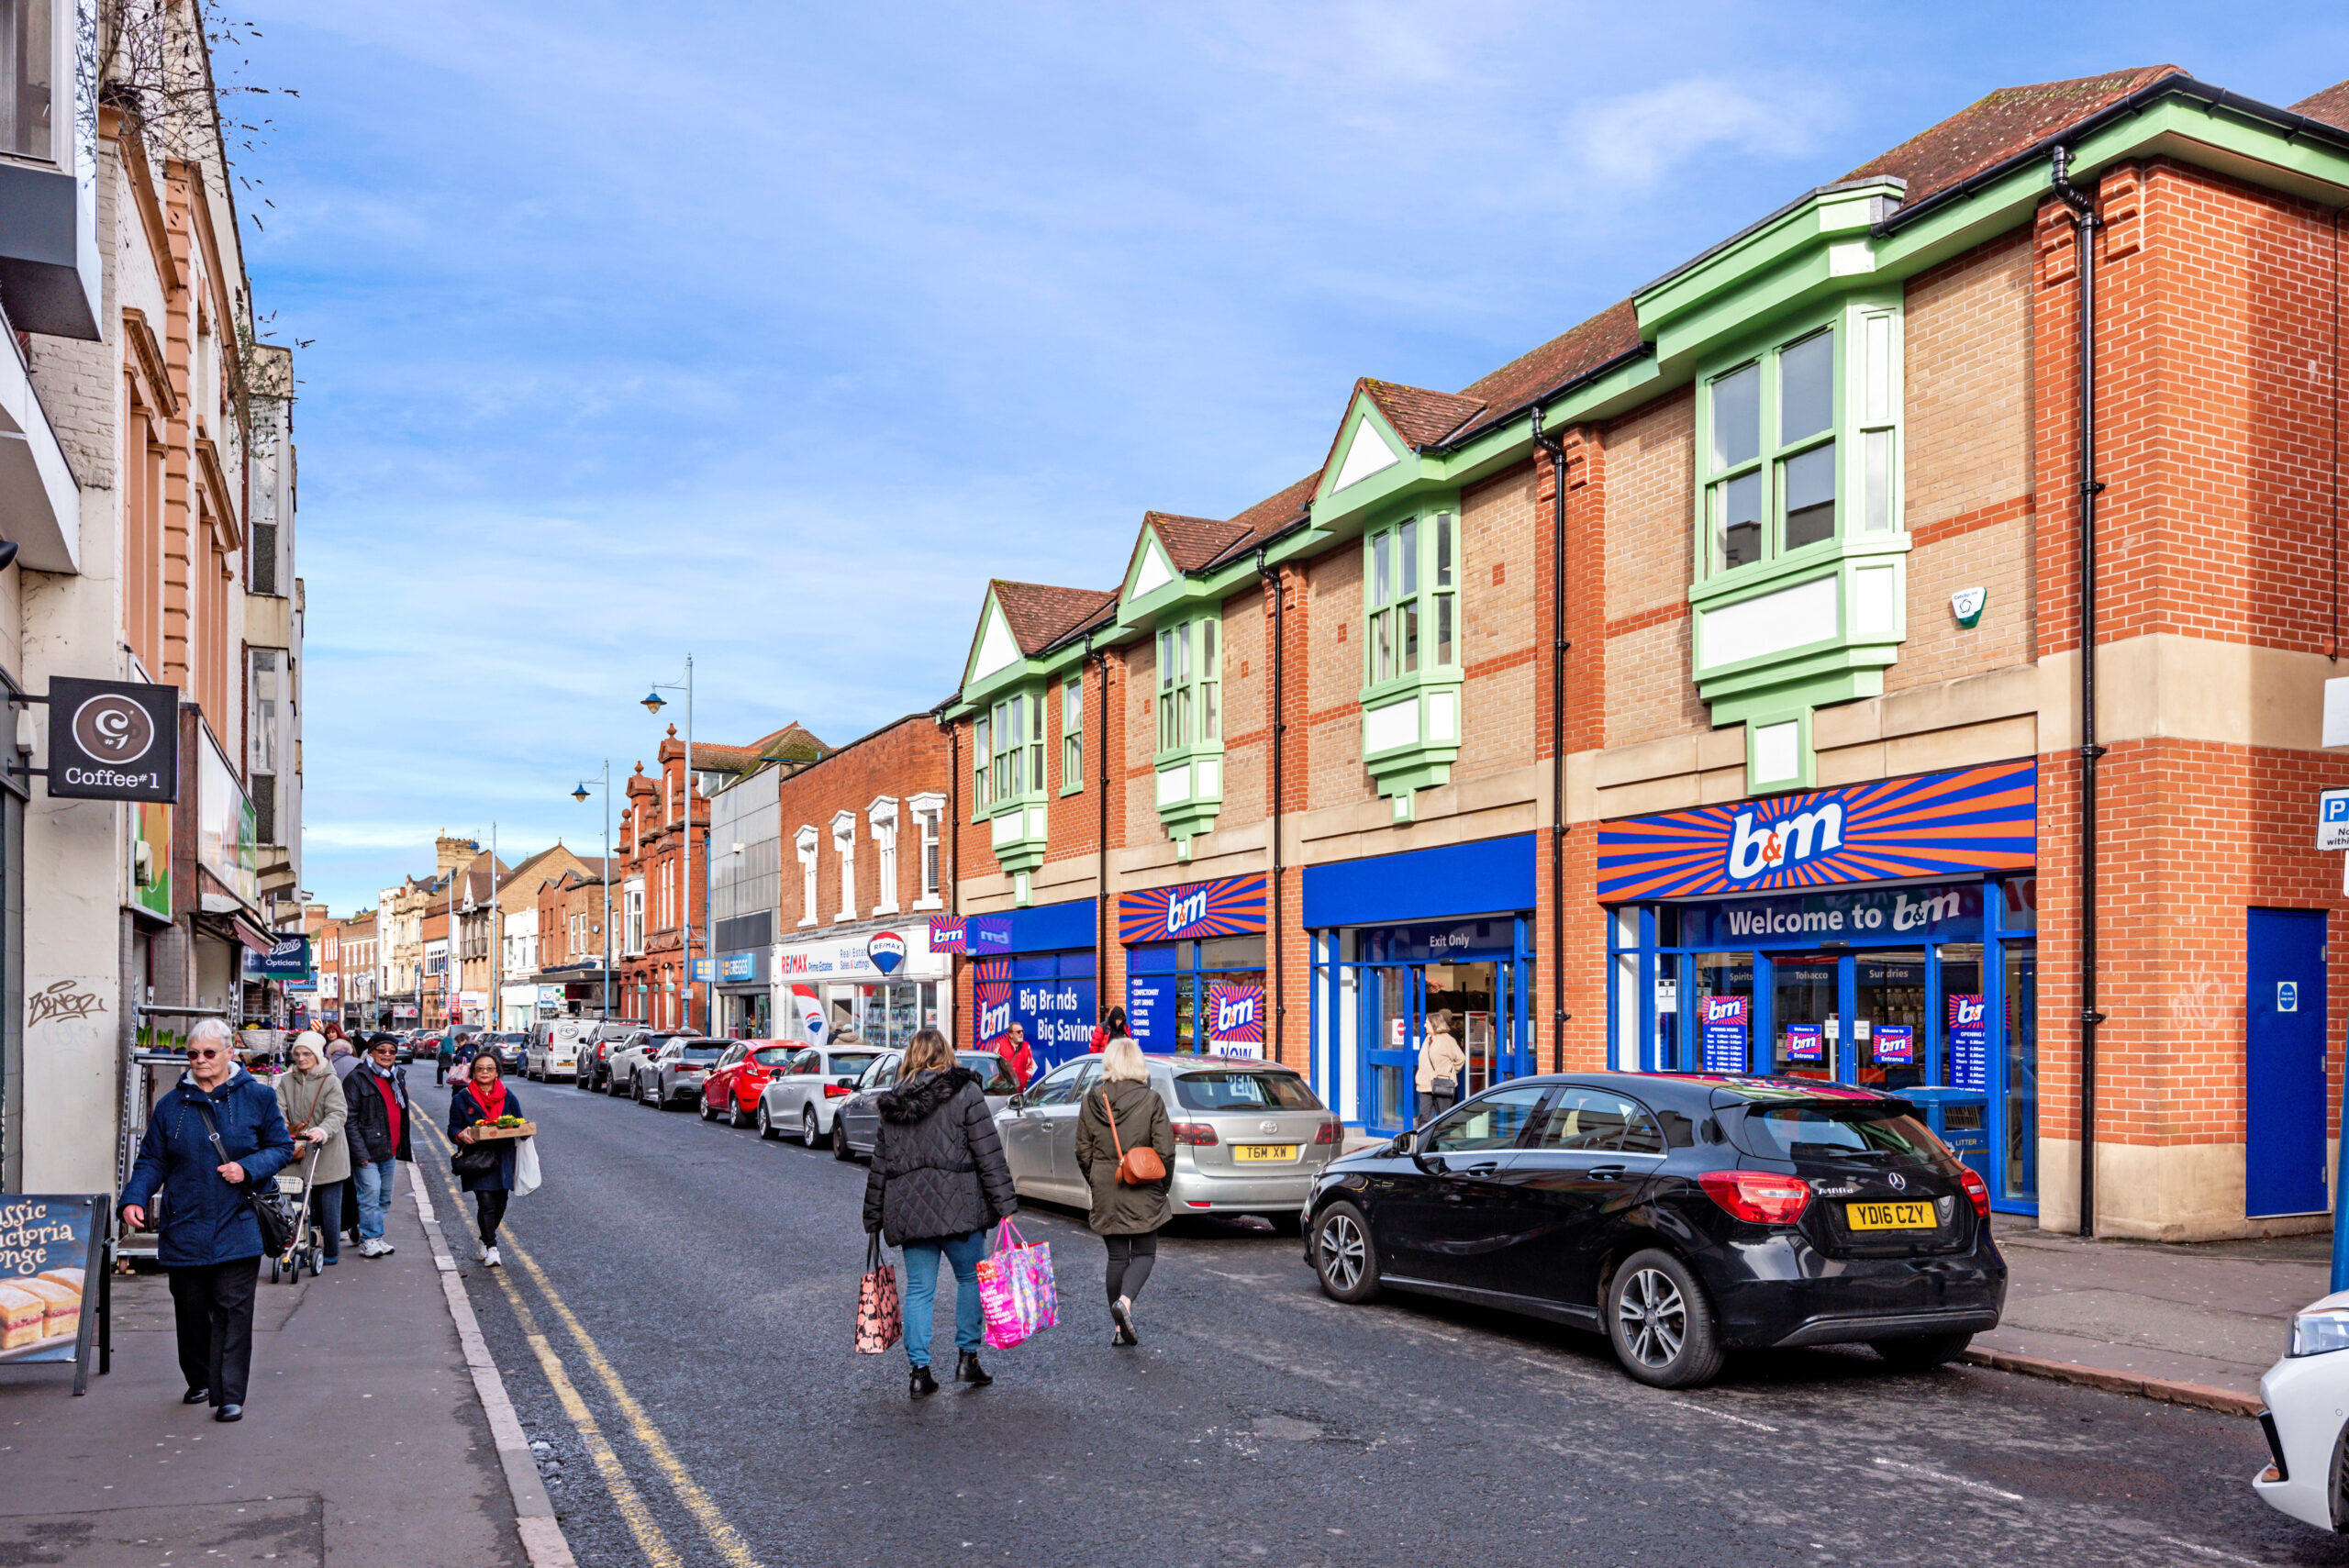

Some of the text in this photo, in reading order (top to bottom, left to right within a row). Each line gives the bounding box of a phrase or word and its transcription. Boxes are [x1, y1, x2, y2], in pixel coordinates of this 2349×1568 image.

[65, 767, 160, 789] Coffee#1
[2330, 800, 2346, 820] P
[1729, 803, 1842, 879] b&m
[1167, 890, 1207, 932] b&m
[1729, 908, 1842, 935] Welcome
[1852, 904, 1882, 929] to
[1893, 892, 1960, 931] b&m
[933, 929, 963, 943] b&m
[1430, 933, 1469, 949] Exit Only
[840, 947, 869, 958] Real Estat
[729, 959, 748, 975] GREGGS
[782, 953, 807, 974] RE/MAX
[1730, 973, 1753, 983] Spirits
[1020, 988, 1037, 1016] Big
[1708, 1000, 1740, 1020] b&m
[980, 1001, 1010, 1040] b&m
[1218, 996, 1253, 1031] b&m
[1038, 1018, 1054, 1047] Big
[1792, 1036, 1816, 1050] b&m
[1879, 1038, 1906, 1053] b&m
[1228, 1074, 1253, 1094] PEN
[1247, 1147, 1286, 1158] T6M XW
[0, 1199, 47, 1228] ssic
[1856, 1205, 1923, 1225] YD16 CZY
